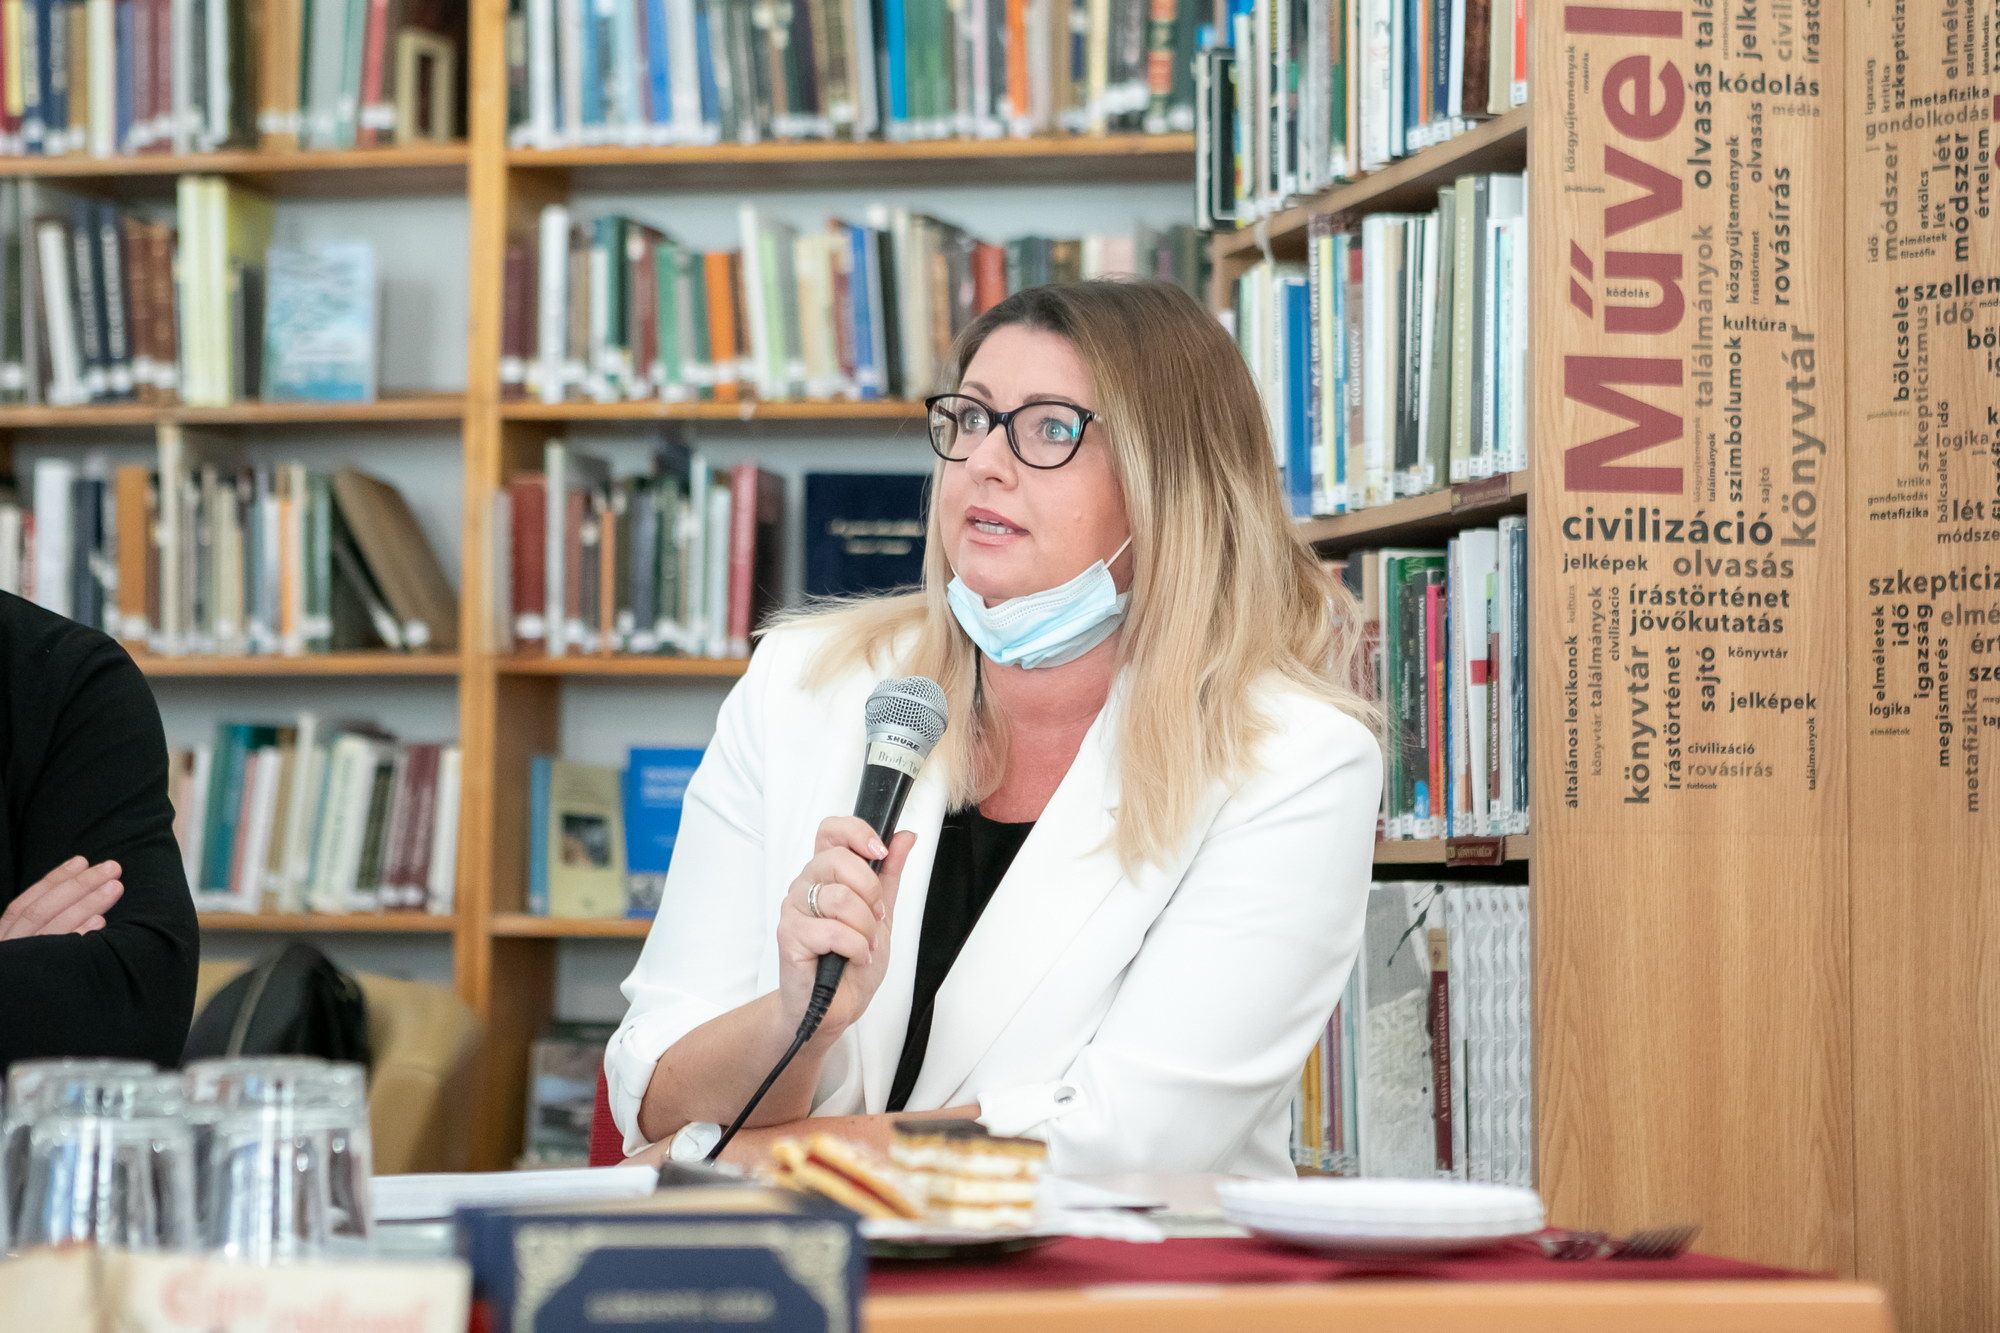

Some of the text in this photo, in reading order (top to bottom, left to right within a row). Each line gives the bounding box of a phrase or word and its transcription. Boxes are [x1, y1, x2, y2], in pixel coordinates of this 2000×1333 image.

[1736, 0, 1763, 61] jelk
[1892, 0, 1909, 110] szkepticiz
[1719, 70, 1820, 97] kódolás
[1910, 86, 1990, 108] metafizika
[1687, 62, 1713, 190] olvasás
[1772, 103, 1820, 118] média
[1866, 104, 1990, 140] gondolkodás
[1746, 102, 1763, 183] olvasás
[1932, 133, 1951, 172] lét
[1974, 129, 1990, 219] értelem
[1880, 142, 1898, 261] módszer
[1933, 202, 1946, 229] lét
[1949, 132, 1969, 262] módszer
[1725, 135, 1743, 304] közgyűjtemények
[1768, 167, 1790, 306] rovásírás
[1564, 5, 1685, 495] Művel
[1606, 287, 1651, 299] kódolás
[1691, 225, 1718, 409] találmányok
[1723, 313, 1788, 332] kultúra
[1935, 301, 1974, 326] idő
[1892, 285, 1909, 402] bölcselet
[1913, 305, 1933, 472] szkepticizmus
[1724, 336, 1742, 502] szimbólumok
[1781, 325, 1826, 547] könyvtár
[1936, 429, 1990, 452] logika
[1758, 466, 1773, 504] sajtó
[1867, 492, 1929, 506] gondolkodás
[1897, 477, 1931, 488] kritika
[1562, 506, 1773, 546] civilizáció
[1869, 507, 1929, 521] metafizika
[1953, 499, 1986, 522] lét
[1563, 553, 1648, 575] jelképek
[1673, 549, 1794, 579] olvasás
[1629, 584, 1790, 608] írástörténet
[1629, 609, 1784, 636] jövőkutatás
[1892, 604, 1909, 646] idő
[1587, 586, 1605, 710] találmányok
[1728, 646, 1788, 661] könyvtár
[1871, 605, 1885, 701] elméletek
[1913, 604, 1934, 699] igazság
[1696, 646, 1721, 713] sajtó
[1565, 634, 1578, 809] általános lexikonok
[1664, 646, 1681, 790] írástörténet
[1729, 691, 1817, 715] jelképek
[1869, 701, 1911, 719] logika
[1935, 637, 1953, 767] megismerés
[886, 734, 920, 752] SHURE
[1624, 645, 1657, 804] könyvtár
[1687, 742, 1755, 755] civilizáció
[1962, 688, 1979, 813] metafizika
[1687, 761, 1773, 778] rovásírás
